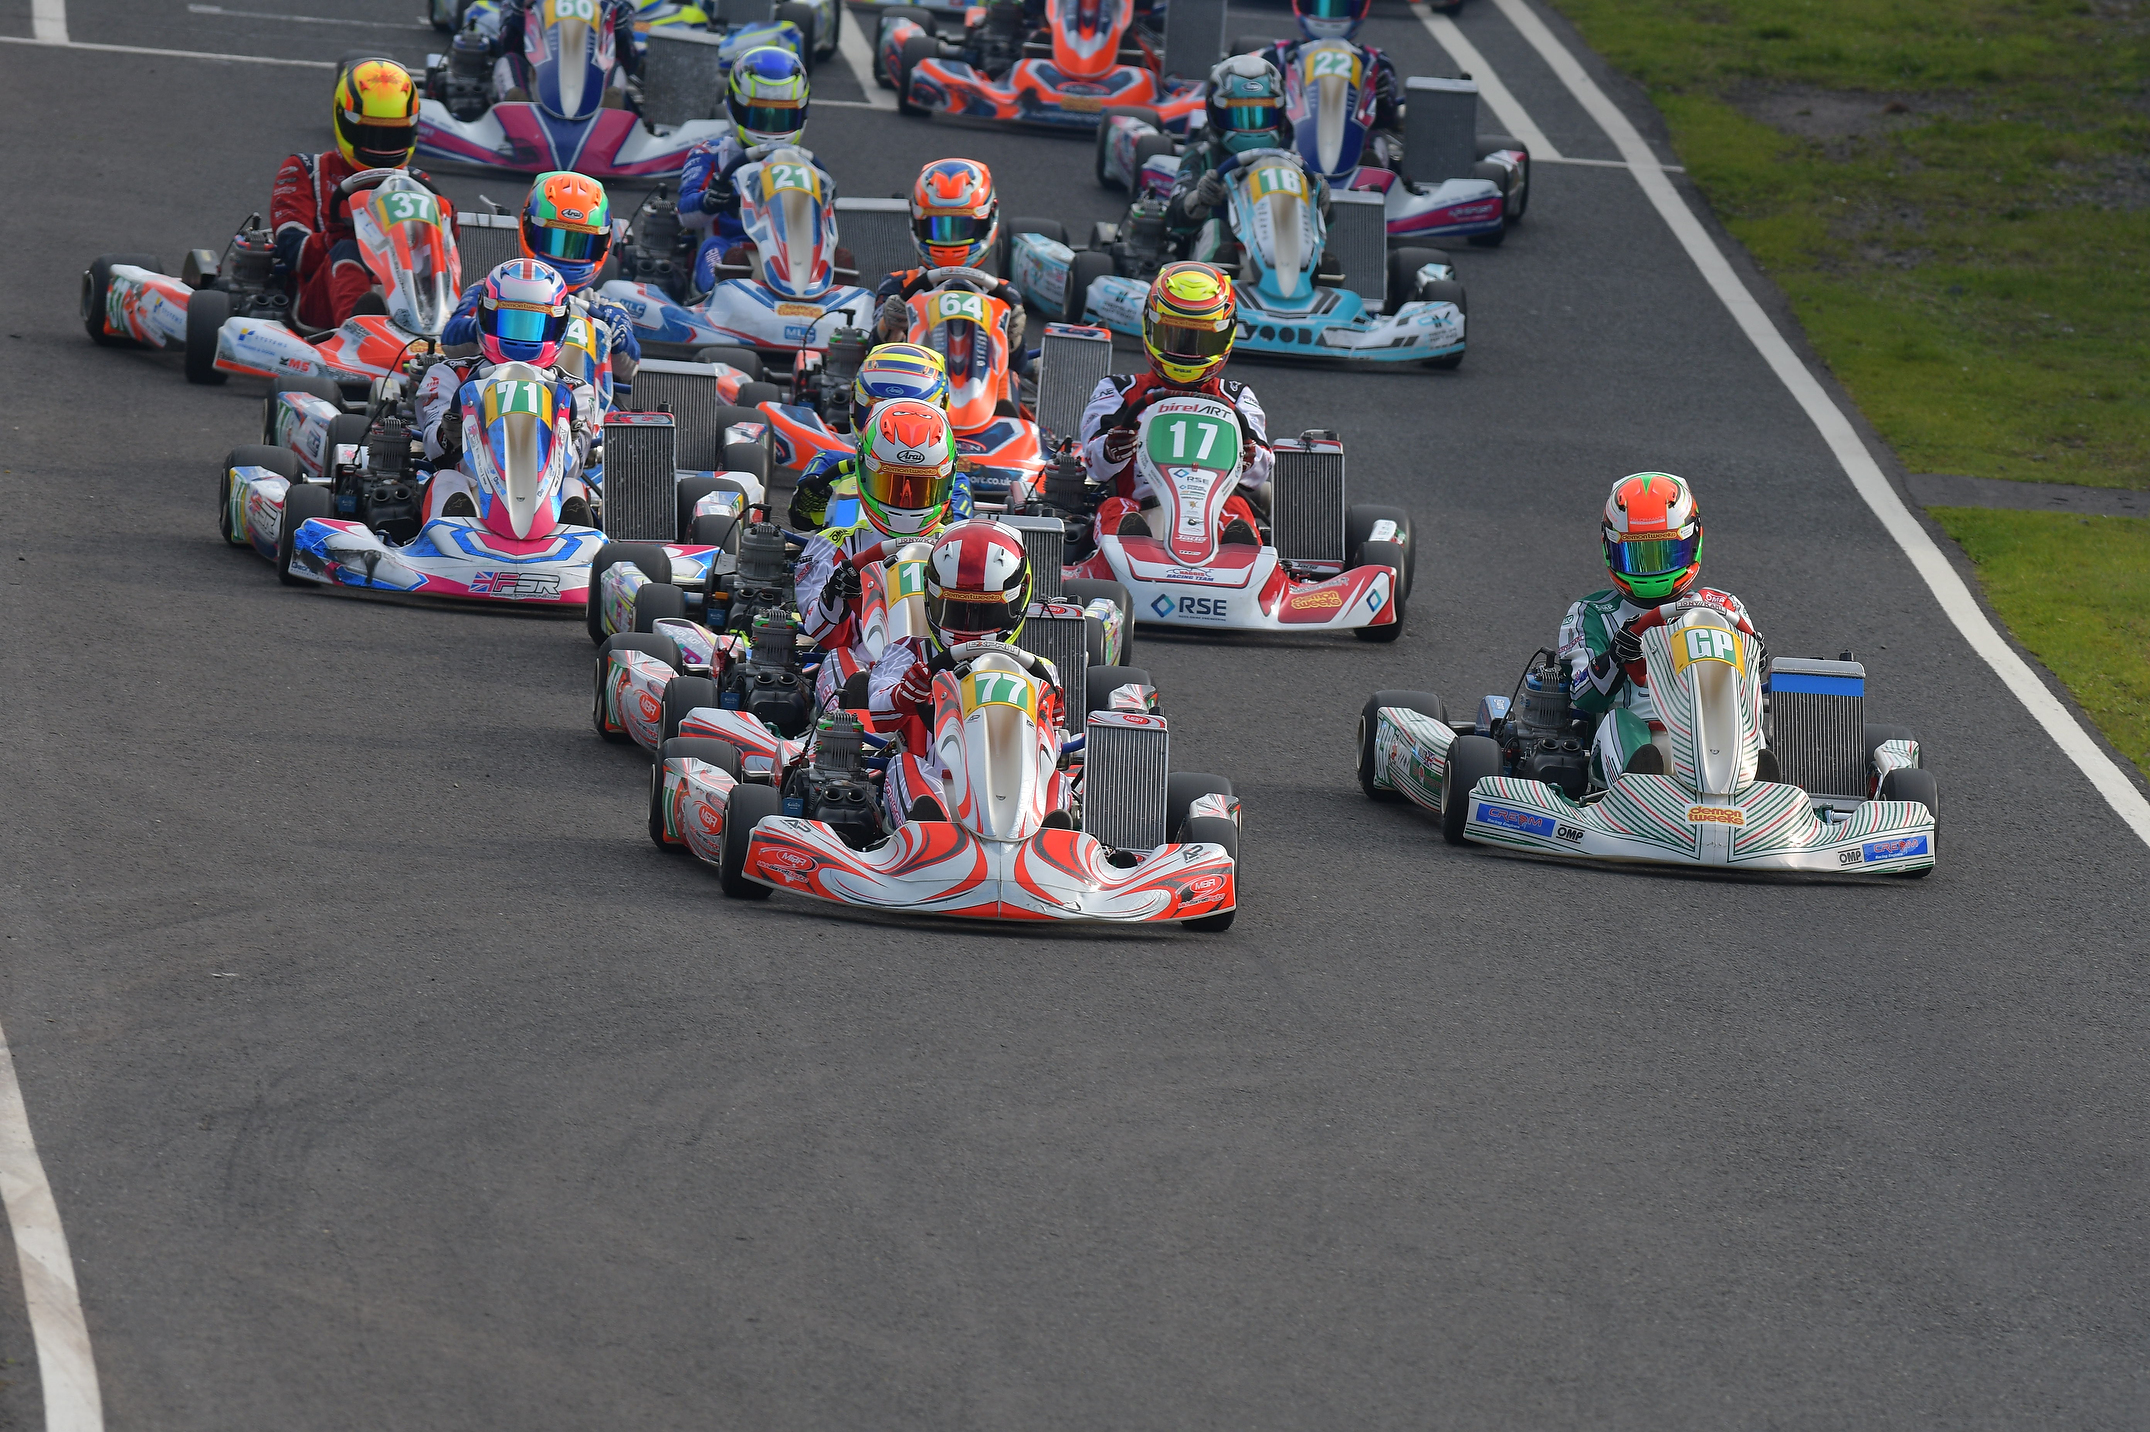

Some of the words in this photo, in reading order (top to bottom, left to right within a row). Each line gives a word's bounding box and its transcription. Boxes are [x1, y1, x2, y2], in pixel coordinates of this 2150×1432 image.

[1313, 51, 1353, 78] 22
[771, 164, 812, 192] 21
[1259, 168, 1302, 194] 16
[390, 192, 430, 219] 37
[939, 292, 983, 320] 64
[279, 356, 311, 373] KMS
[496, 380, 539, 414] 71
[1158, 402, 1232, 419] birelART
[1170, 420, 1218, 460] 17
[898, 450, 922, 461] Arai
[969, 476, 1012, 486] ort.co.uk
[943, 591, 1002, 601] demontweeks
[1179, 596, 1227, 617] RSE
[967, 641, 1020, 653] EXPRIT
[1686, 628, 1734, 660] GP
[975, 673, 1028, 705] 77
[1688, 813, 1744, 825] tweeks
[1690, 806, 1742, 818] demon
[1557, 827, 1584, 841] OMP
[781, 852, 807, 866] MBR
[1840, 850, 1862, 863] OMP
[1195, 879, 1216, 890] MBR
